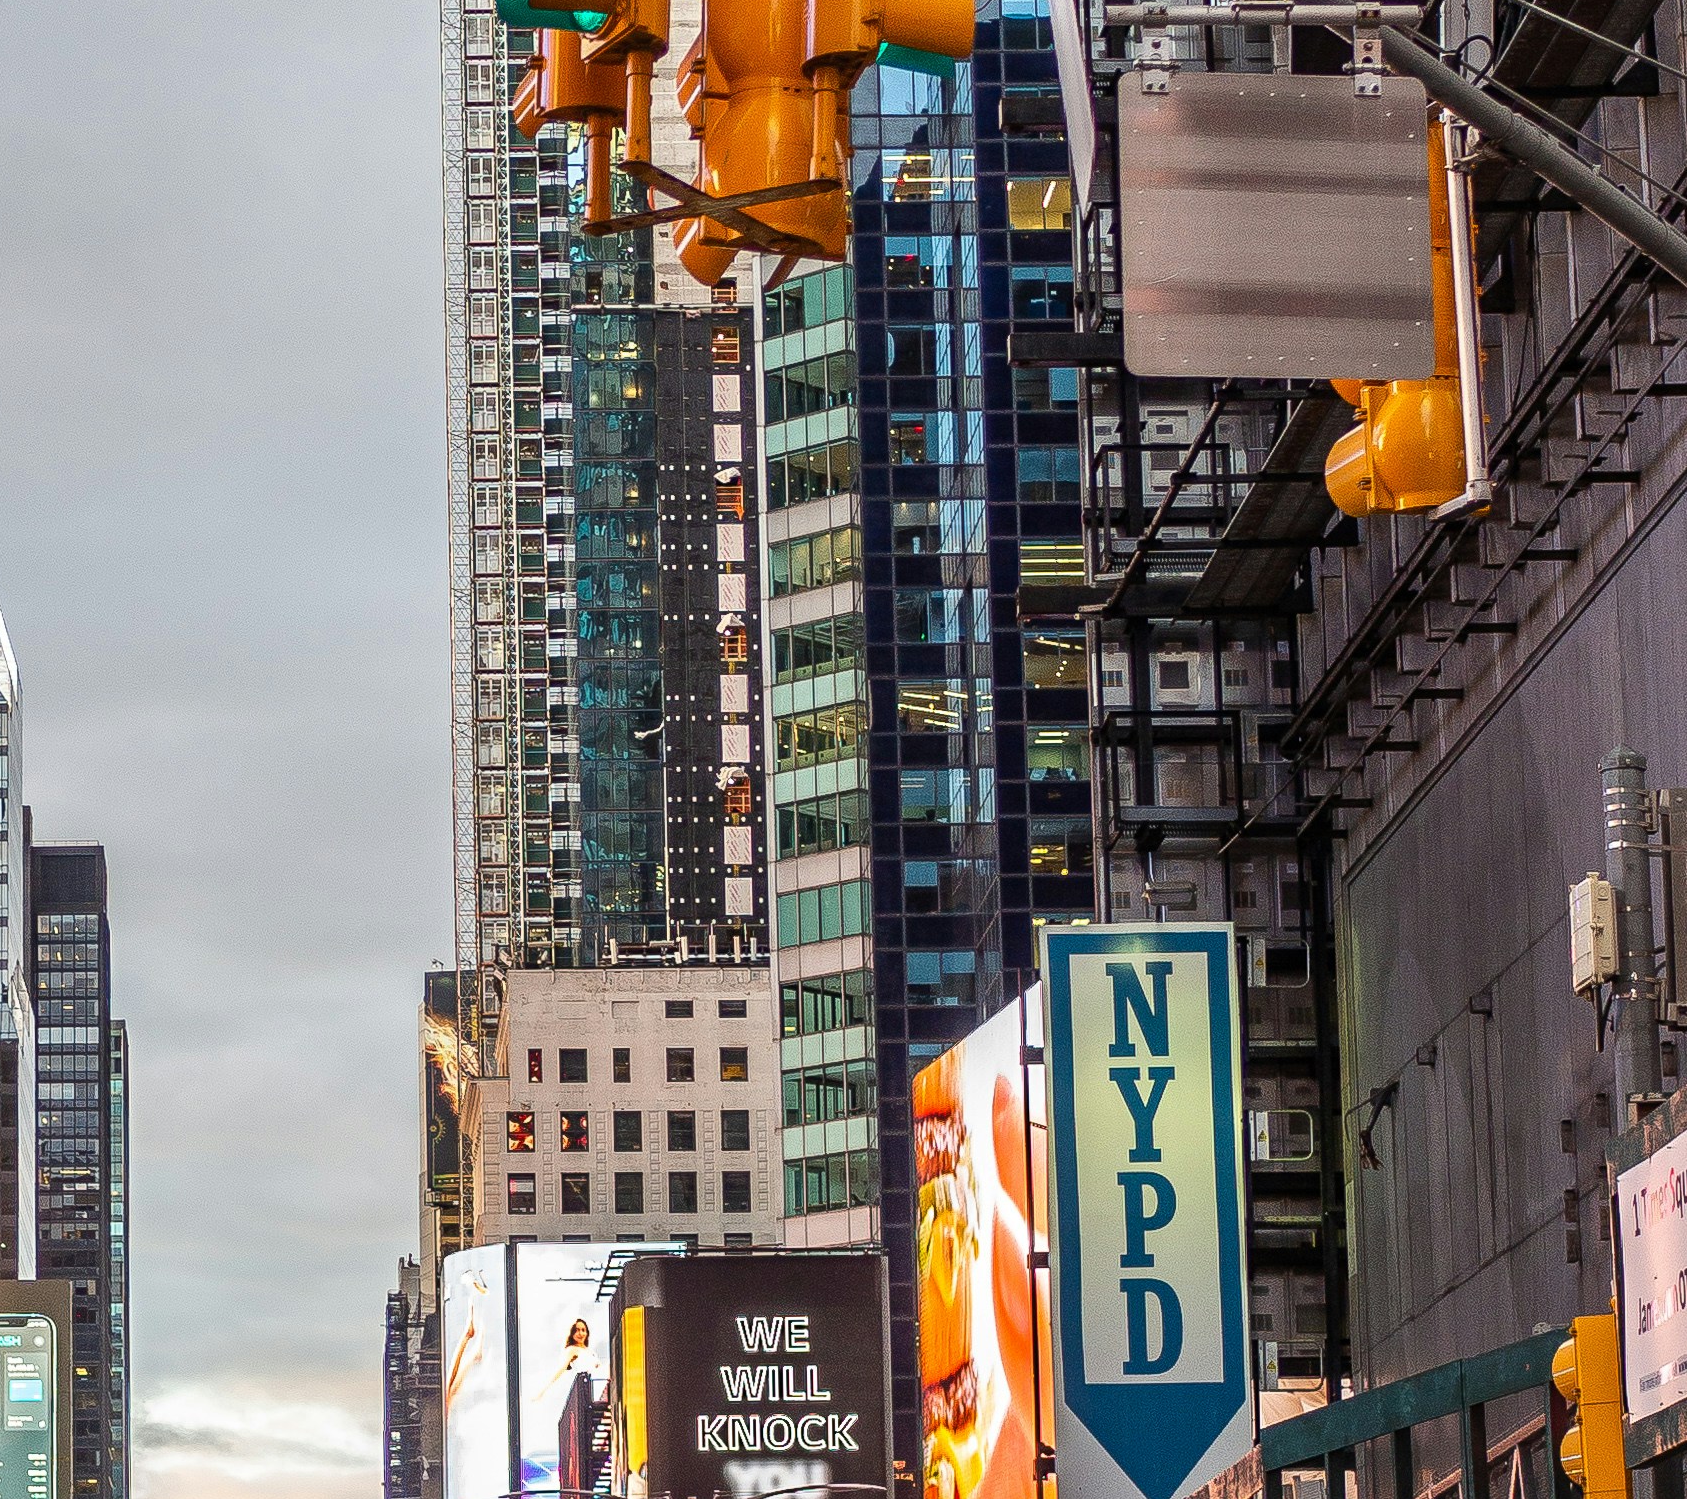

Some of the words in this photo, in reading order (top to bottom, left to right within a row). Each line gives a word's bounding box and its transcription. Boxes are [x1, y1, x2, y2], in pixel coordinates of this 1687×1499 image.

[1105, 961, 1183, 1376] NYPD
[1632, 1194, 1642, 1237] 1
[736, 1316, 810, 1352] WE
[720, 1366, 831, 1401] WILL
[697, 1414, 859, 1451] KNOCK
